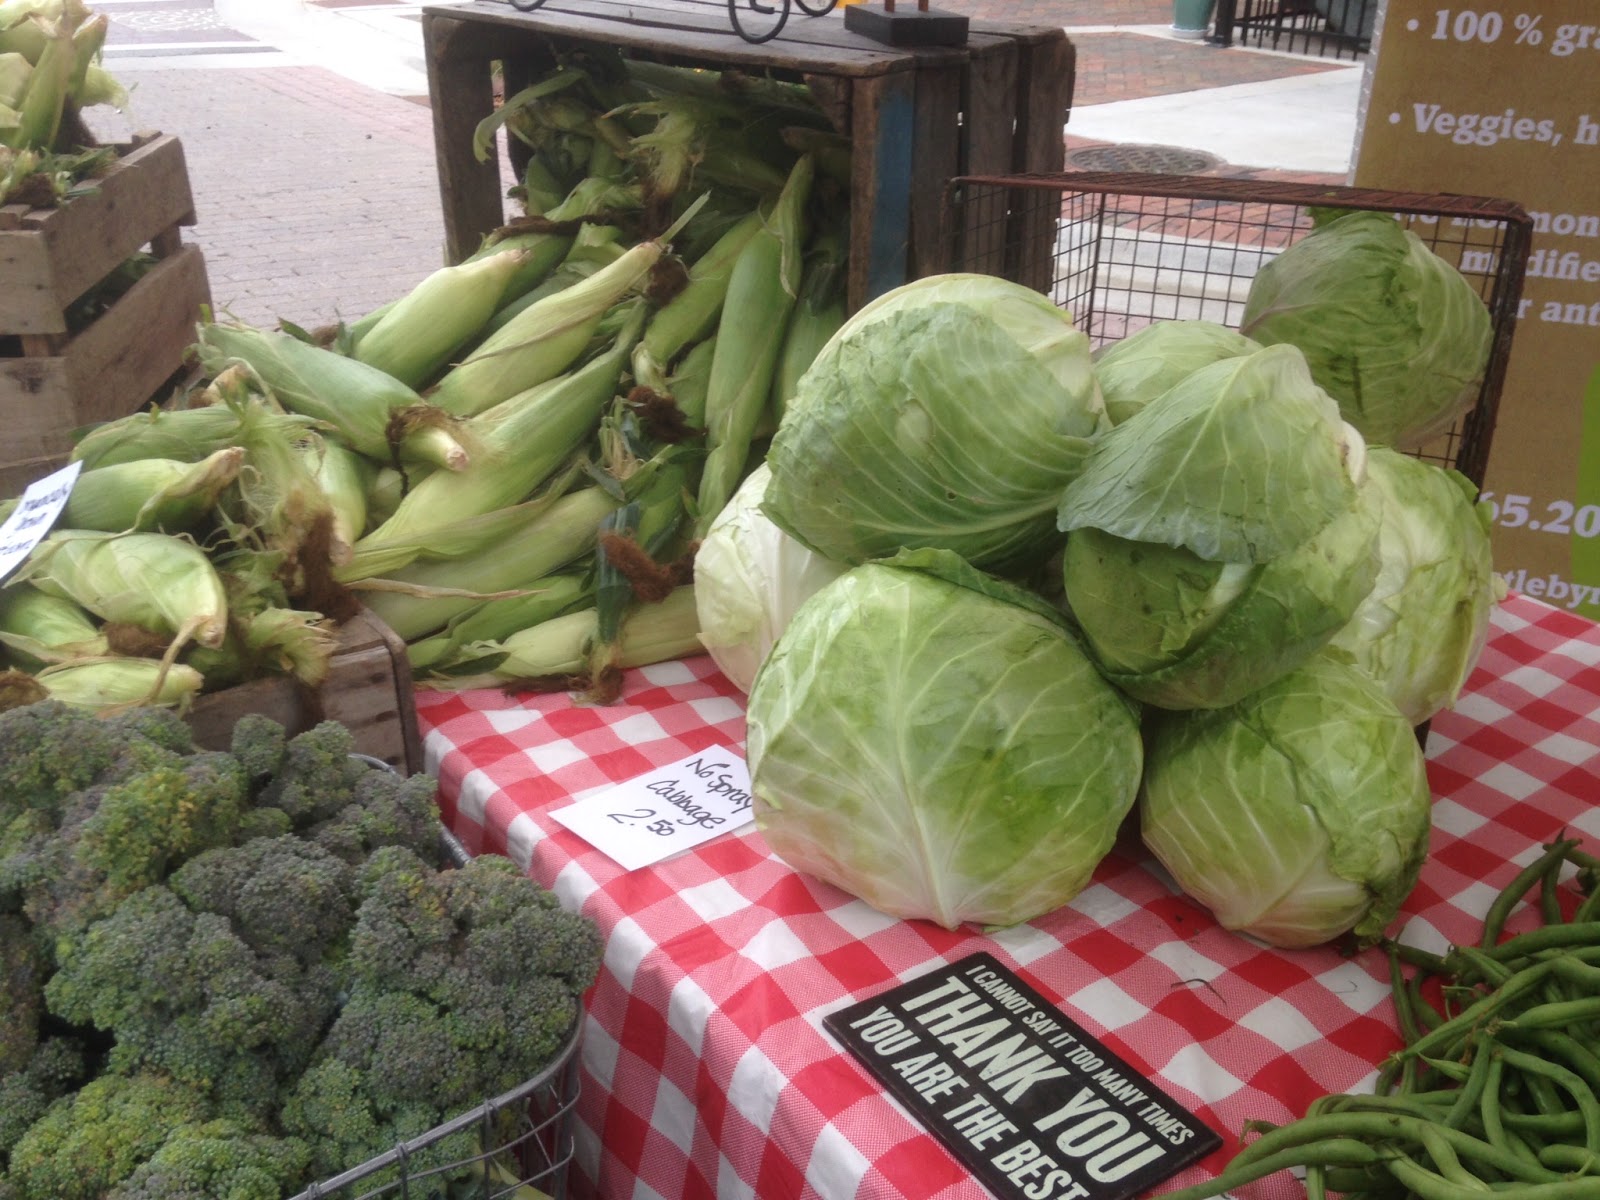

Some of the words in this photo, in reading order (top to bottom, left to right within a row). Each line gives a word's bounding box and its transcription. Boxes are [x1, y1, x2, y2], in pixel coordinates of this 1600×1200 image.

[1432, 9, 1503, 43] 100
[1514, 14, 1543, 46] %
[1413, 103, 1563, 146] Veggies,
[1459, 249, 1600, 283] mdifie
[686, 758, 731, 779] No
[646, 779, 727, 830] Cabbage
[706, 774, 753, 814] Spray
[973, 970, 1036, 1014] CANNOT
[1022, 1011, 1062, 1036] SAY
[1048, 1031, 1077, 1049] IT
[1065, 1044, 1104, 1074] TOO
[1092, 1067, 1149, 1107] MANY
[1136, 1101, 1195, 1146] TIMES
[900, 976, 1072, 1106] THANK
[1032, 1086, 1167, 1184] YOU
[849, 1005, 922, 1056] YOU
[892, 1052, 970, 1105] ARE
[942, 1093, 1020, 1152] THE
[990, 1139, 1090, 1200] BEST
